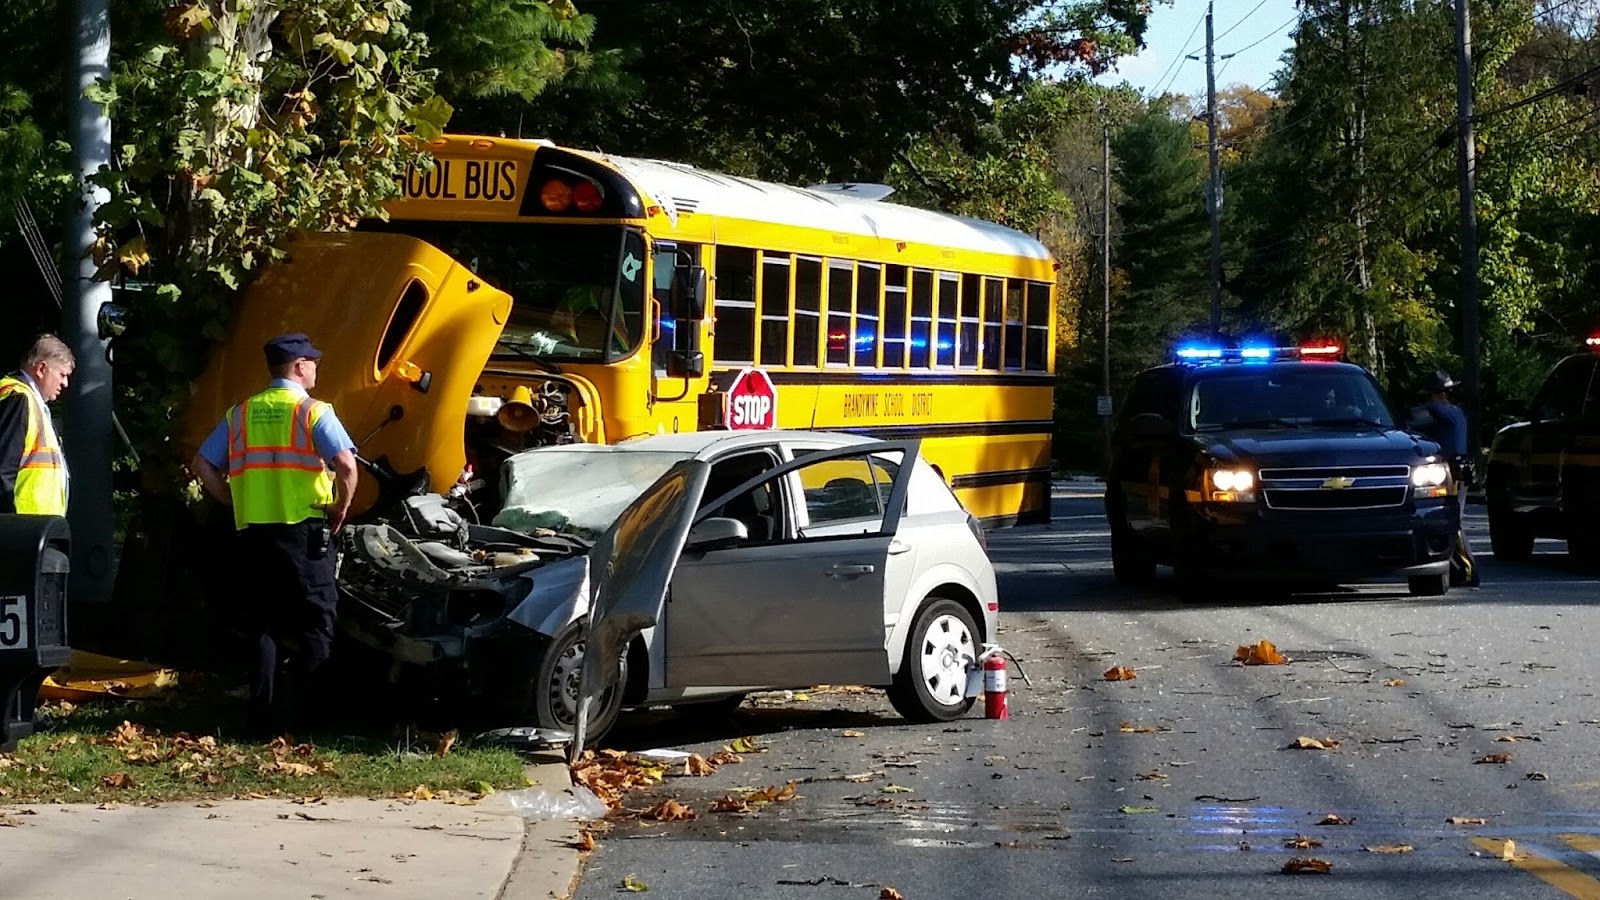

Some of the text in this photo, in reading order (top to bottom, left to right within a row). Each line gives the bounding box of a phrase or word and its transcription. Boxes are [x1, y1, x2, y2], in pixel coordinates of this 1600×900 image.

[464, 161, 516, 201] BUS
[734, 395, 771, 426] STOP
[0, 598, 21, 646] 5
